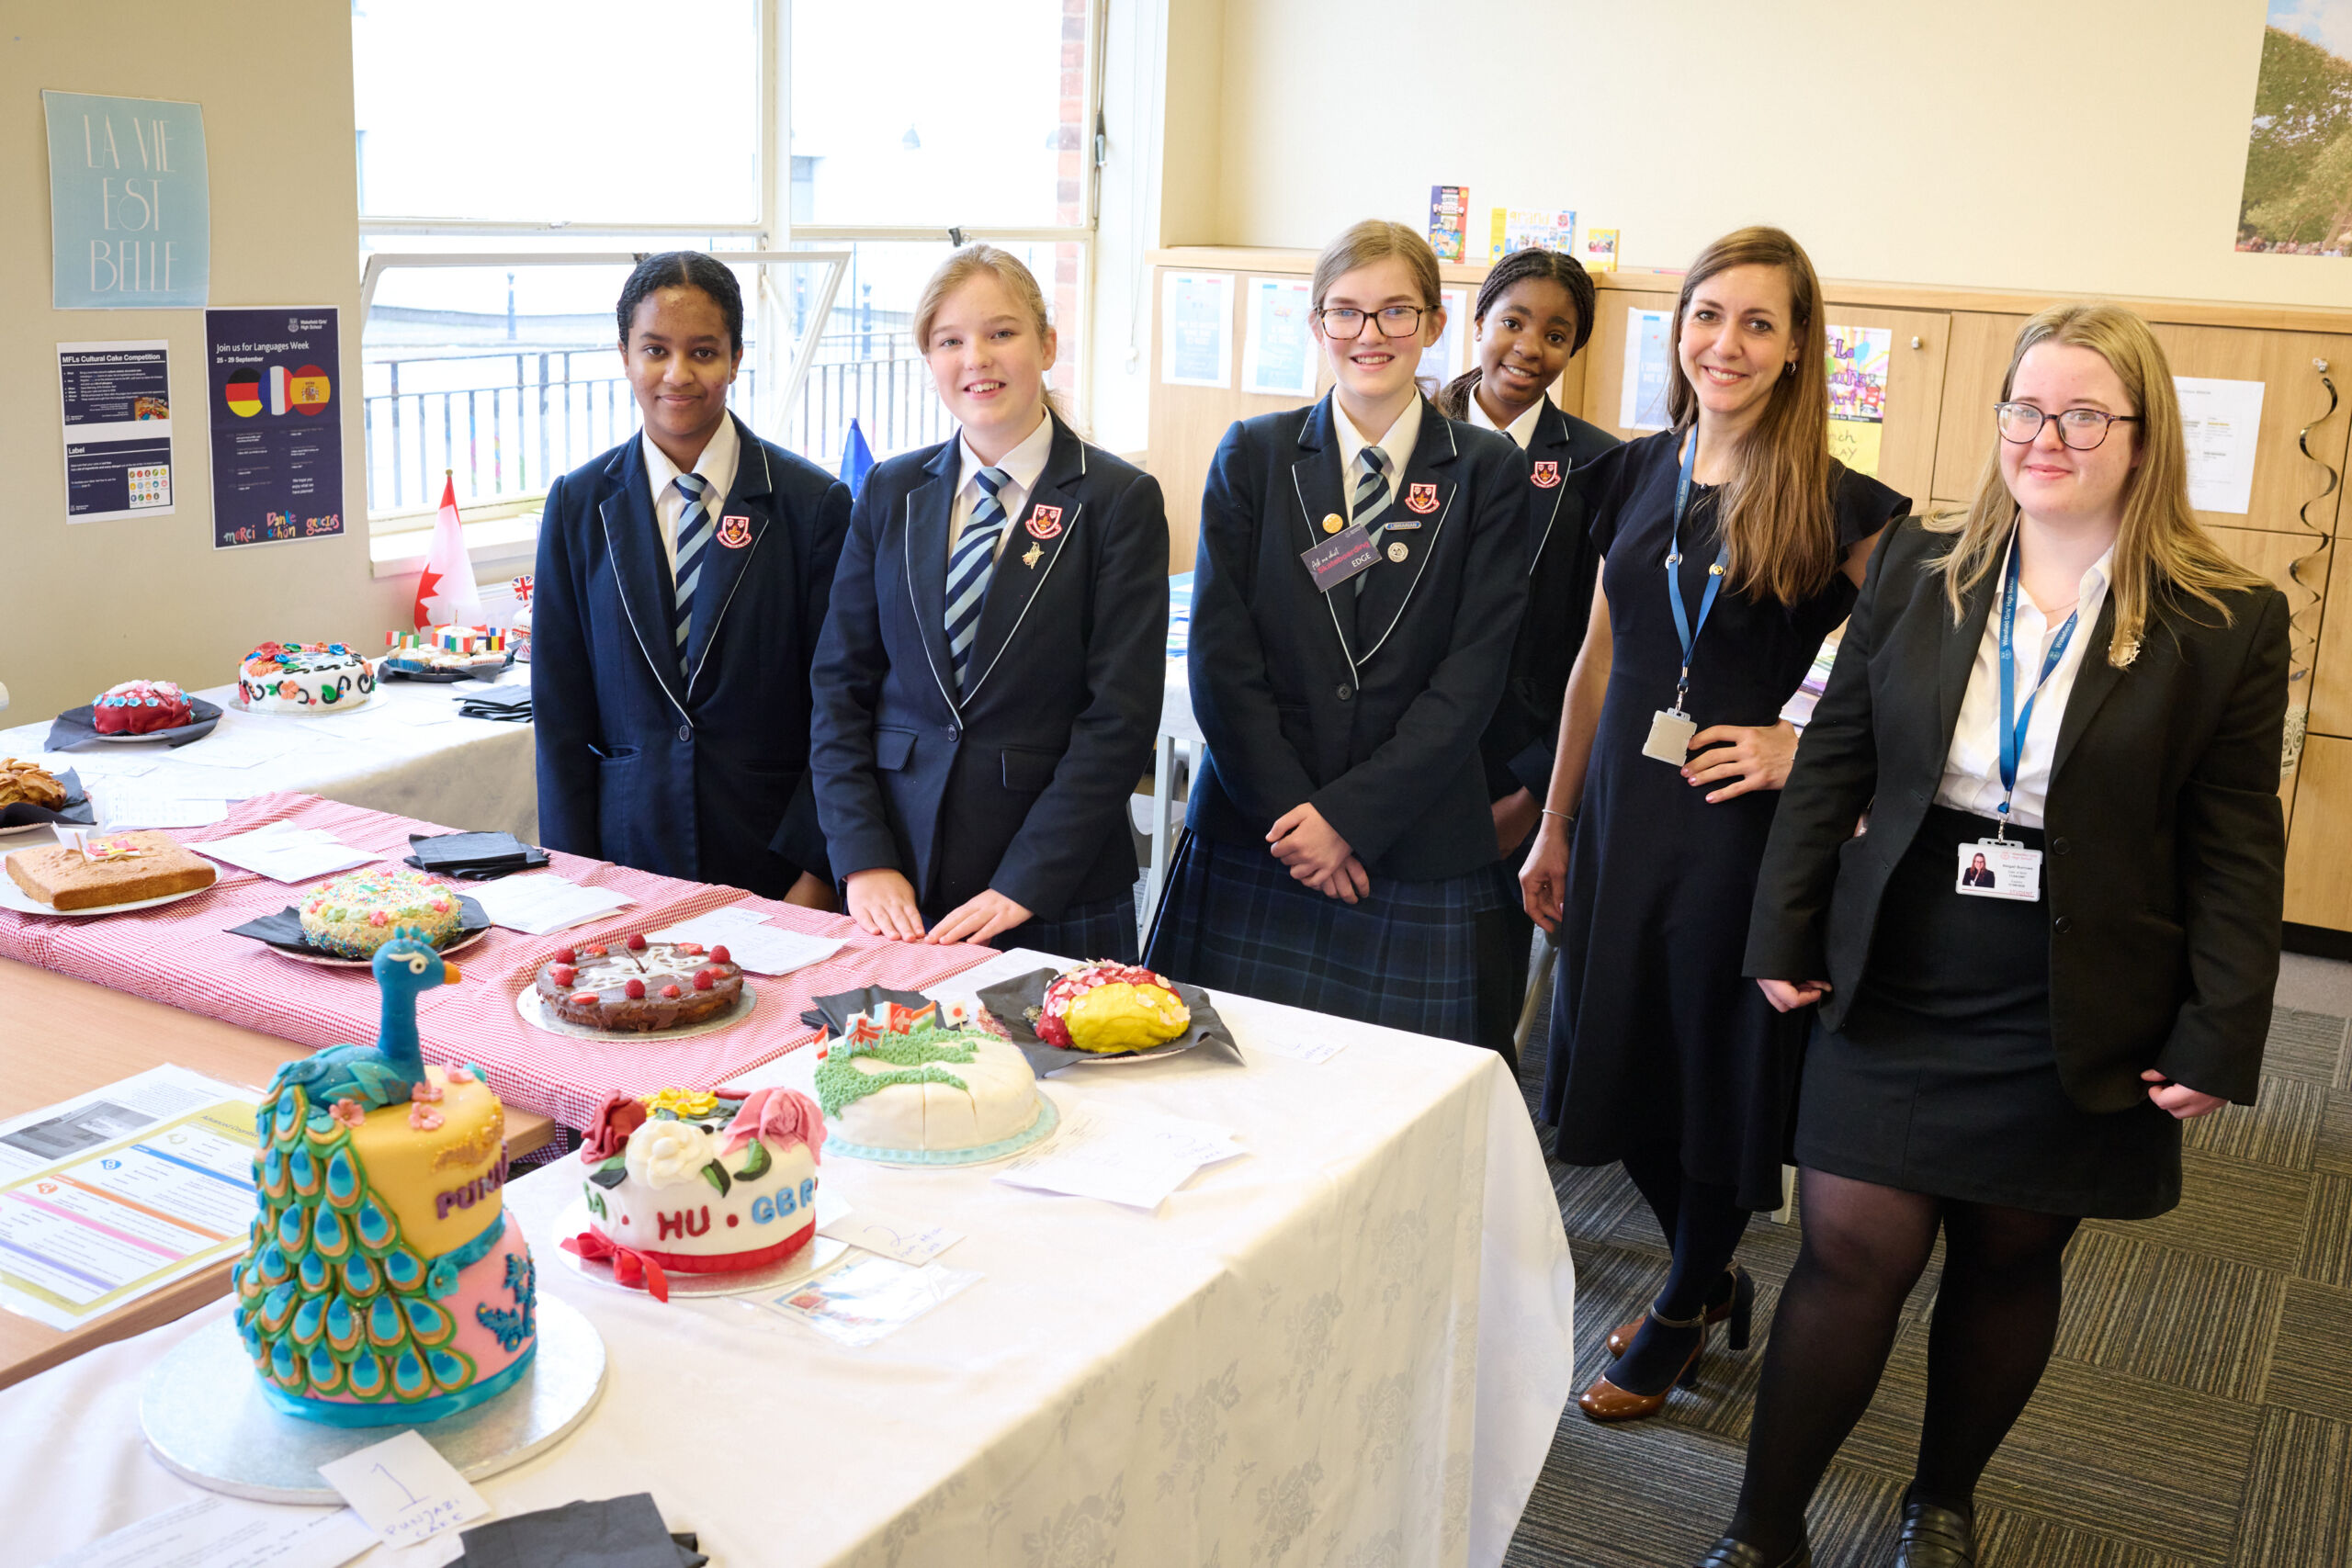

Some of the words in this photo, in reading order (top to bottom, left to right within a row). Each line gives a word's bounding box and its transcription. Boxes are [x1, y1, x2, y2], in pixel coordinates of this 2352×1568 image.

[84, 110, 120, 170] LA
[133, 117, 176, 173] VIE
[103, 177, 163, 231] EST
[90, 240, 178, 292] BELLE
[81, 355, 106, 363] Cultural
[123, 354, 161, 362] Competition
[216, 344, 231, 354] Join
[242, 343, 252, 351] for
[254, 343, 289, 353] Languages
[289, 341, 310, 350] Week
[68, 446, 85, 455] Label
[1317, 540, 1371, 574] Skateboarding
[1351, 552, 1372, 568] EDGE
[657, 1205, 710, 1240] HU
[370, 1462, 431, 1512] 1
